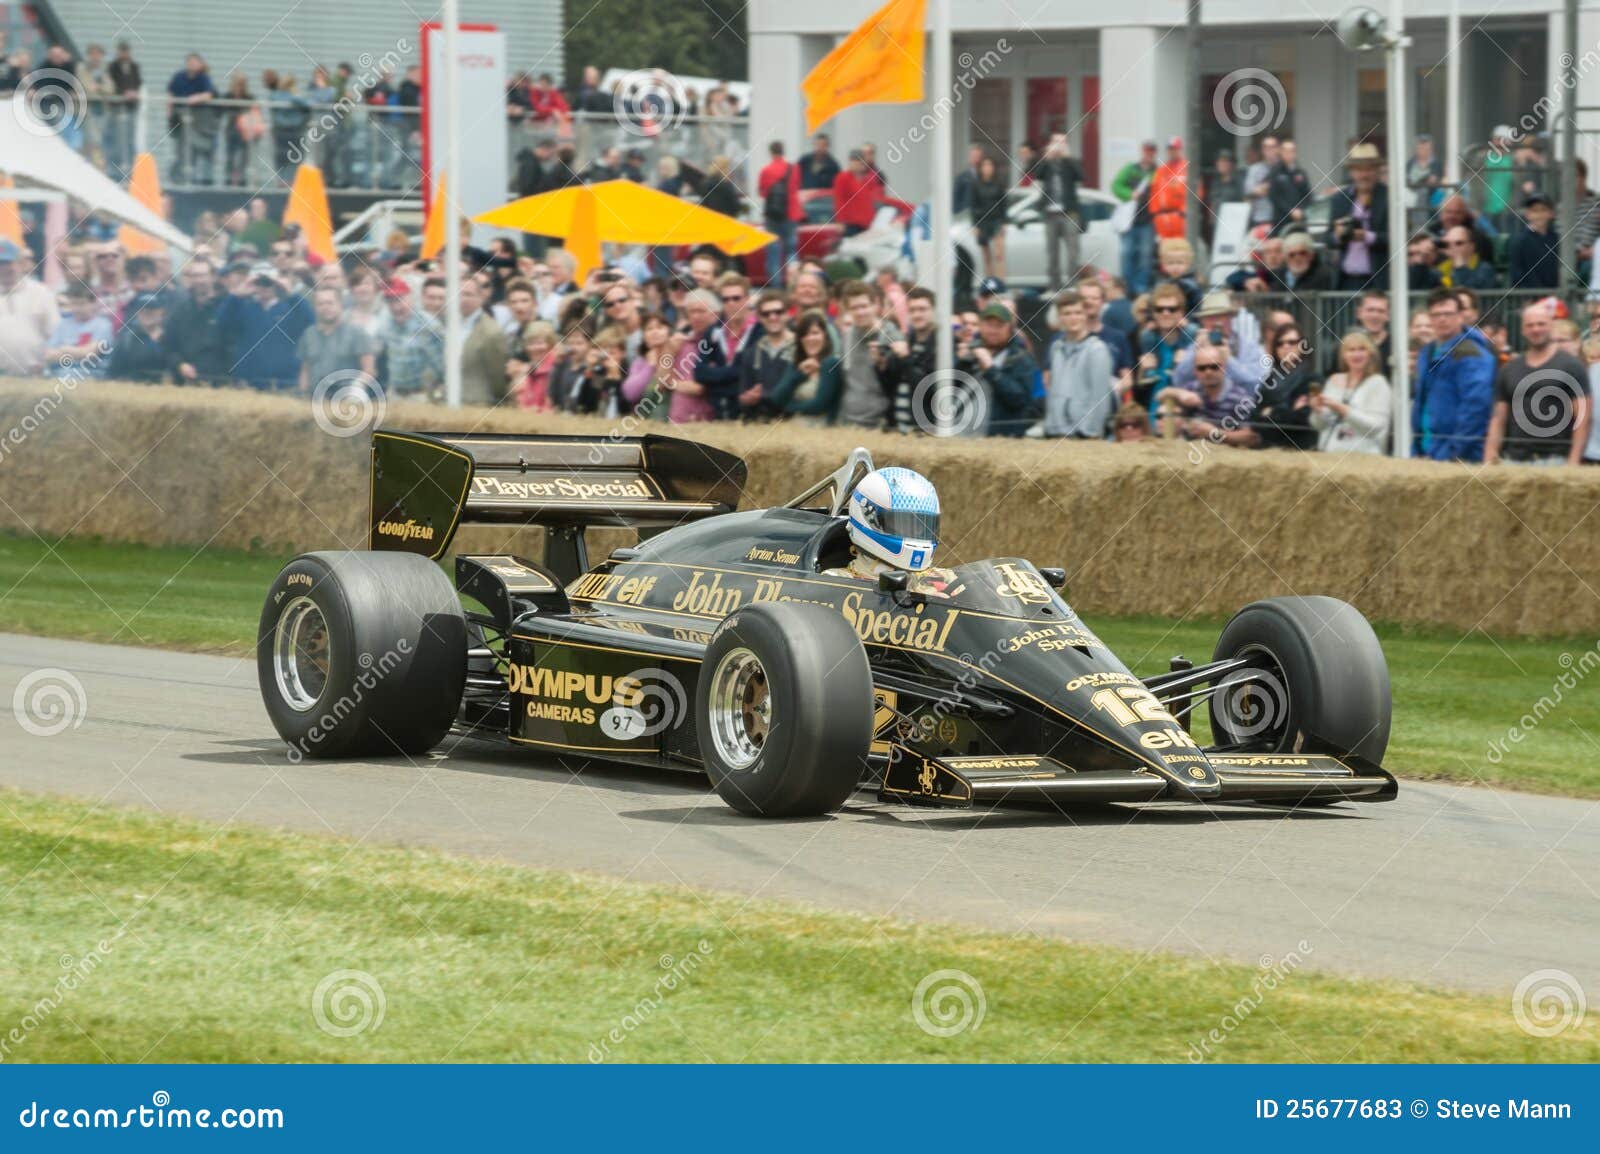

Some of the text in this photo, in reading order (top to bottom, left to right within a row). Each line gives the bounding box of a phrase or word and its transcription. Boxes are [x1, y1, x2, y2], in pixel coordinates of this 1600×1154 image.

[473, 477, 655, 499] Player Special
[378, 519, 434, 541] GOODYEAR
[287, 573, 313, 587] AVON
[616, 575, 658, 604] elf
[672, 570, 742, 616] John
[842, 591, 960, 652] Special
[1009, 628, 1058, 652] John
[507, 662, 646, 707] OLYMPUS
[526, 701, 596, 725] CAMERAS
[1091, 687, 1176, 728] 12
[612, 715, 633, 732] 97
[1209, 756, 1309, 766] OODYEAR
